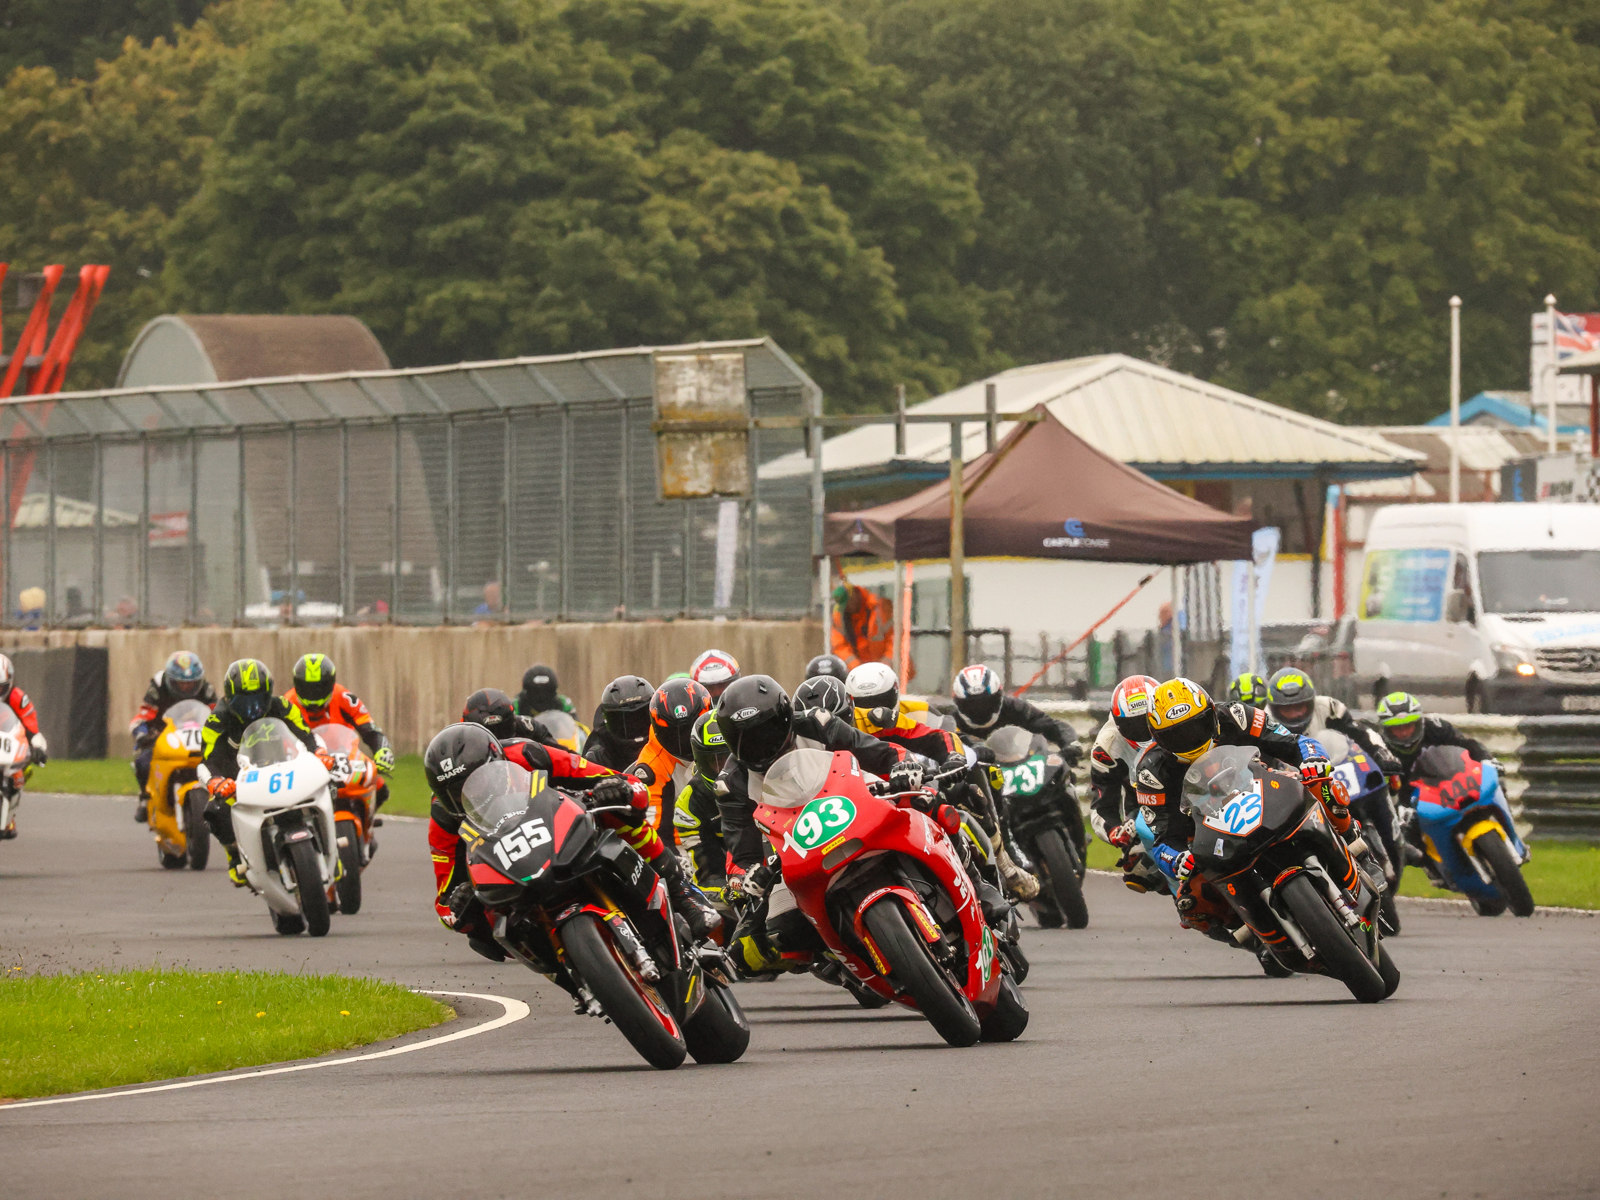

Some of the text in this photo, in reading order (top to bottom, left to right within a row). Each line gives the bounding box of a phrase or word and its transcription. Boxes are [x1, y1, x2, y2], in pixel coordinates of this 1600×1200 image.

[1168, 705, 1189, 717] Arai
[269, 770, 295, 794] 61
[436, 764, 467, 782] SHARK
[1002, 759, 1045, 796] 237
[782, 798, 851, 859] 193
[1224, 793, 1262, 834] 23
[493, 818, 552, 871] 155
